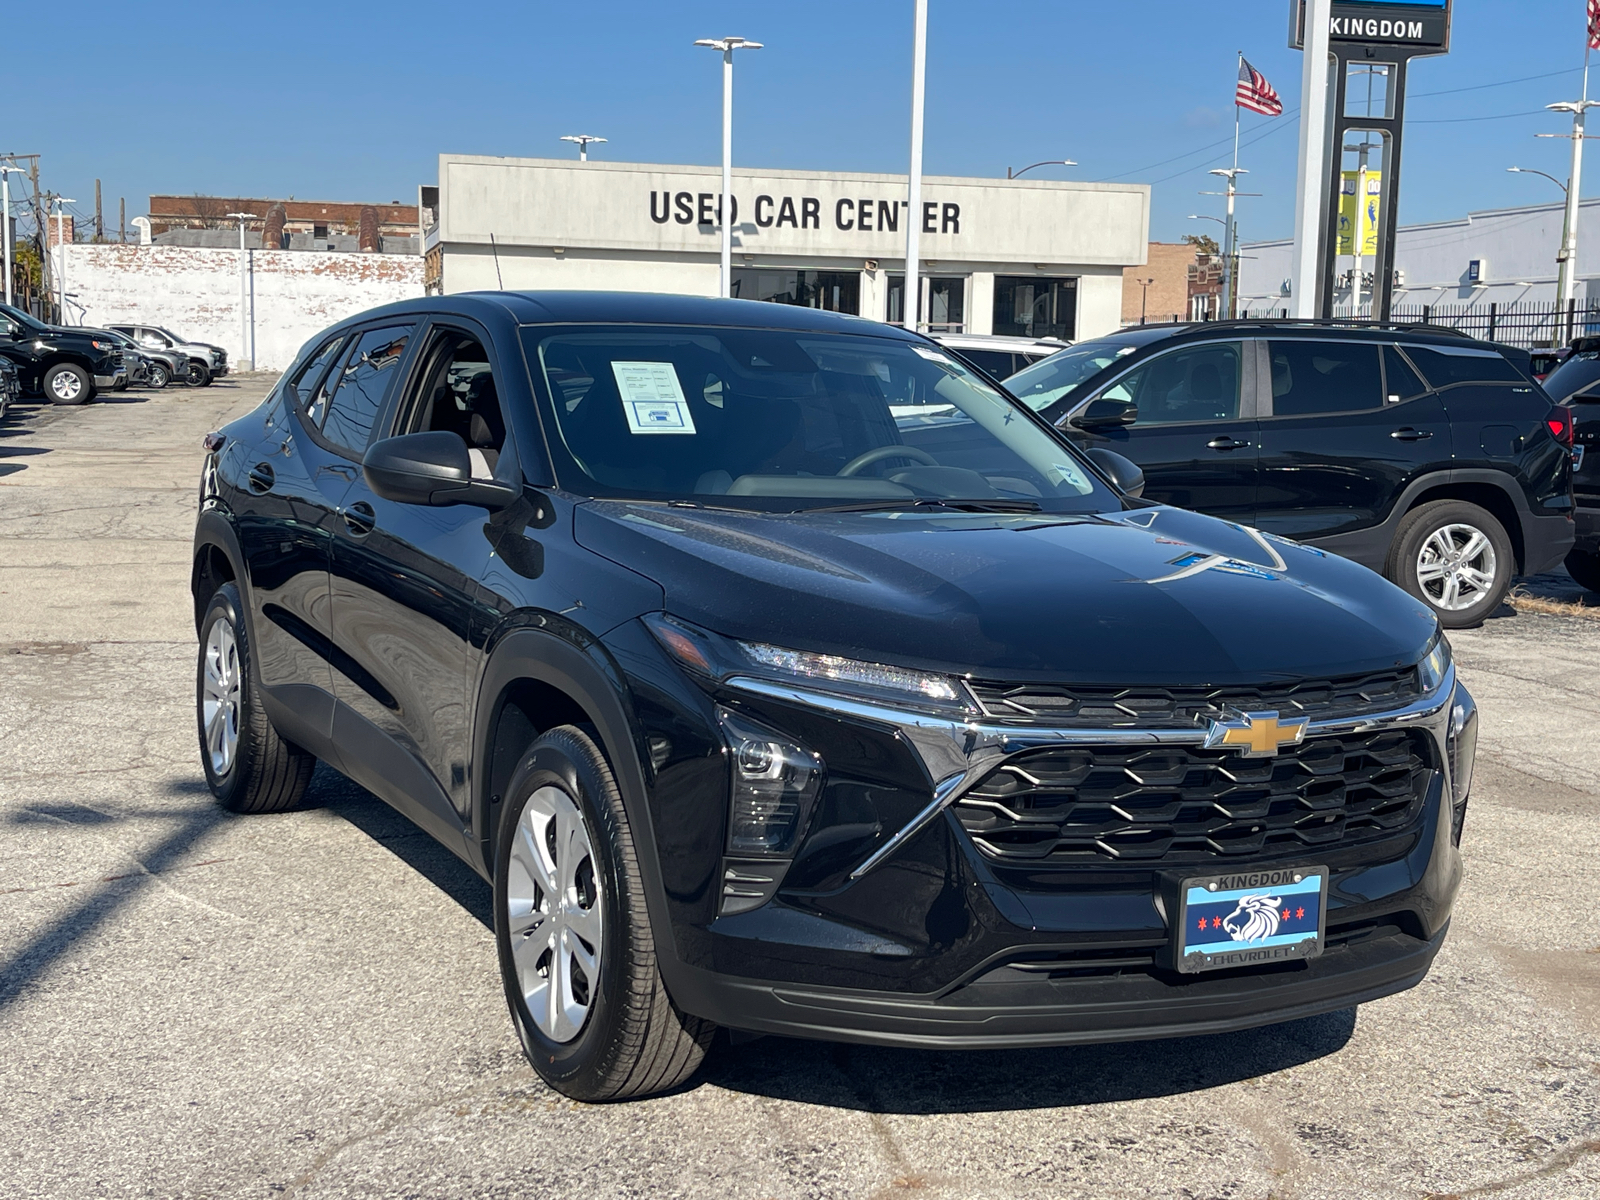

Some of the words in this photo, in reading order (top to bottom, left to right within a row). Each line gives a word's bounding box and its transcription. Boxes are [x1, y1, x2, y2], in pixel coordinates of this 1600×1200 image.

[1330, 17, 1423, 39] KINGDOM
[650, 190, 738, 226] USED
[754, 194, 821, 229] CAR
[1219, 871, 1294, 889] KINGDOM
[1213, 948, 1289, 966] CHEVROLET
